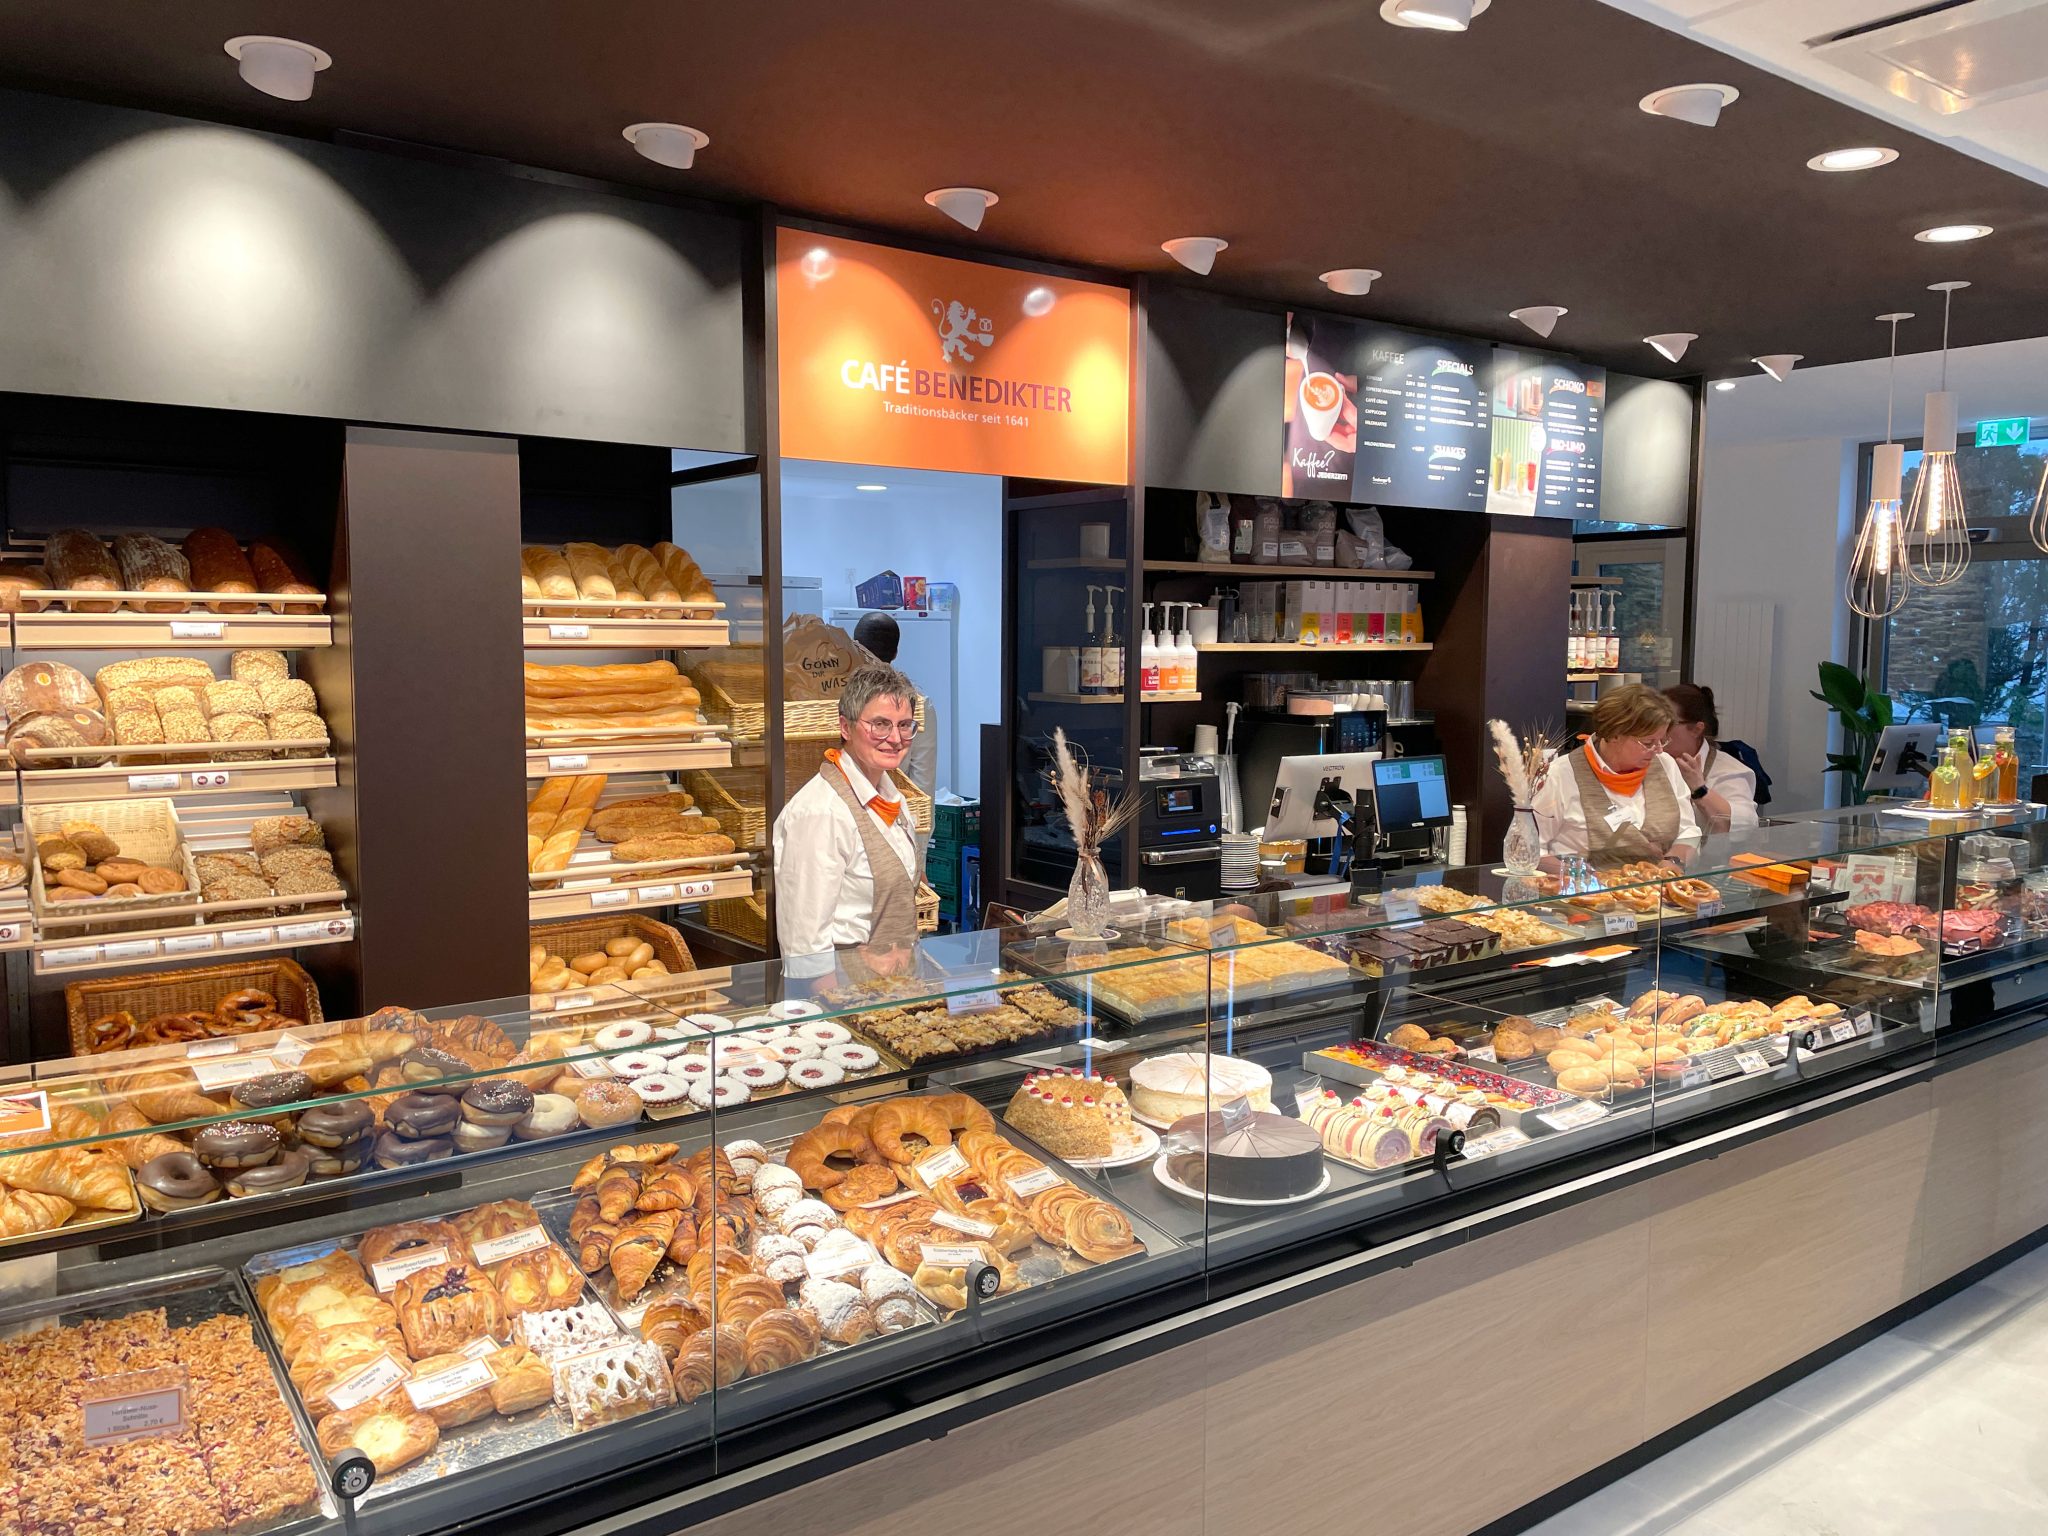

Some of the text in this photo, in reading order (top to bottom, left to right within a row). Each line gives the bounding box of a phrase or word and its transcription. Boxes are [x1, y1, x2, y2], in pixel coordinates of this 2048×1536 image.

[1372, 350, 1404, 364] KAFFEE
[1437, 359, 1474, 375] SPECIALS
[841, 359, 1072, 412] CAFÉ BENEDIKTER
[1554, 378, 1585, 393] SCHOKO
[883, 400, 1029, 427] Traditionsbäcker seit 1641
[1433, 444, 1467, 457] SHAKES
[1293, 447, 1335, 478] Kaffee?
[821, 677, 847, 692] WAS
